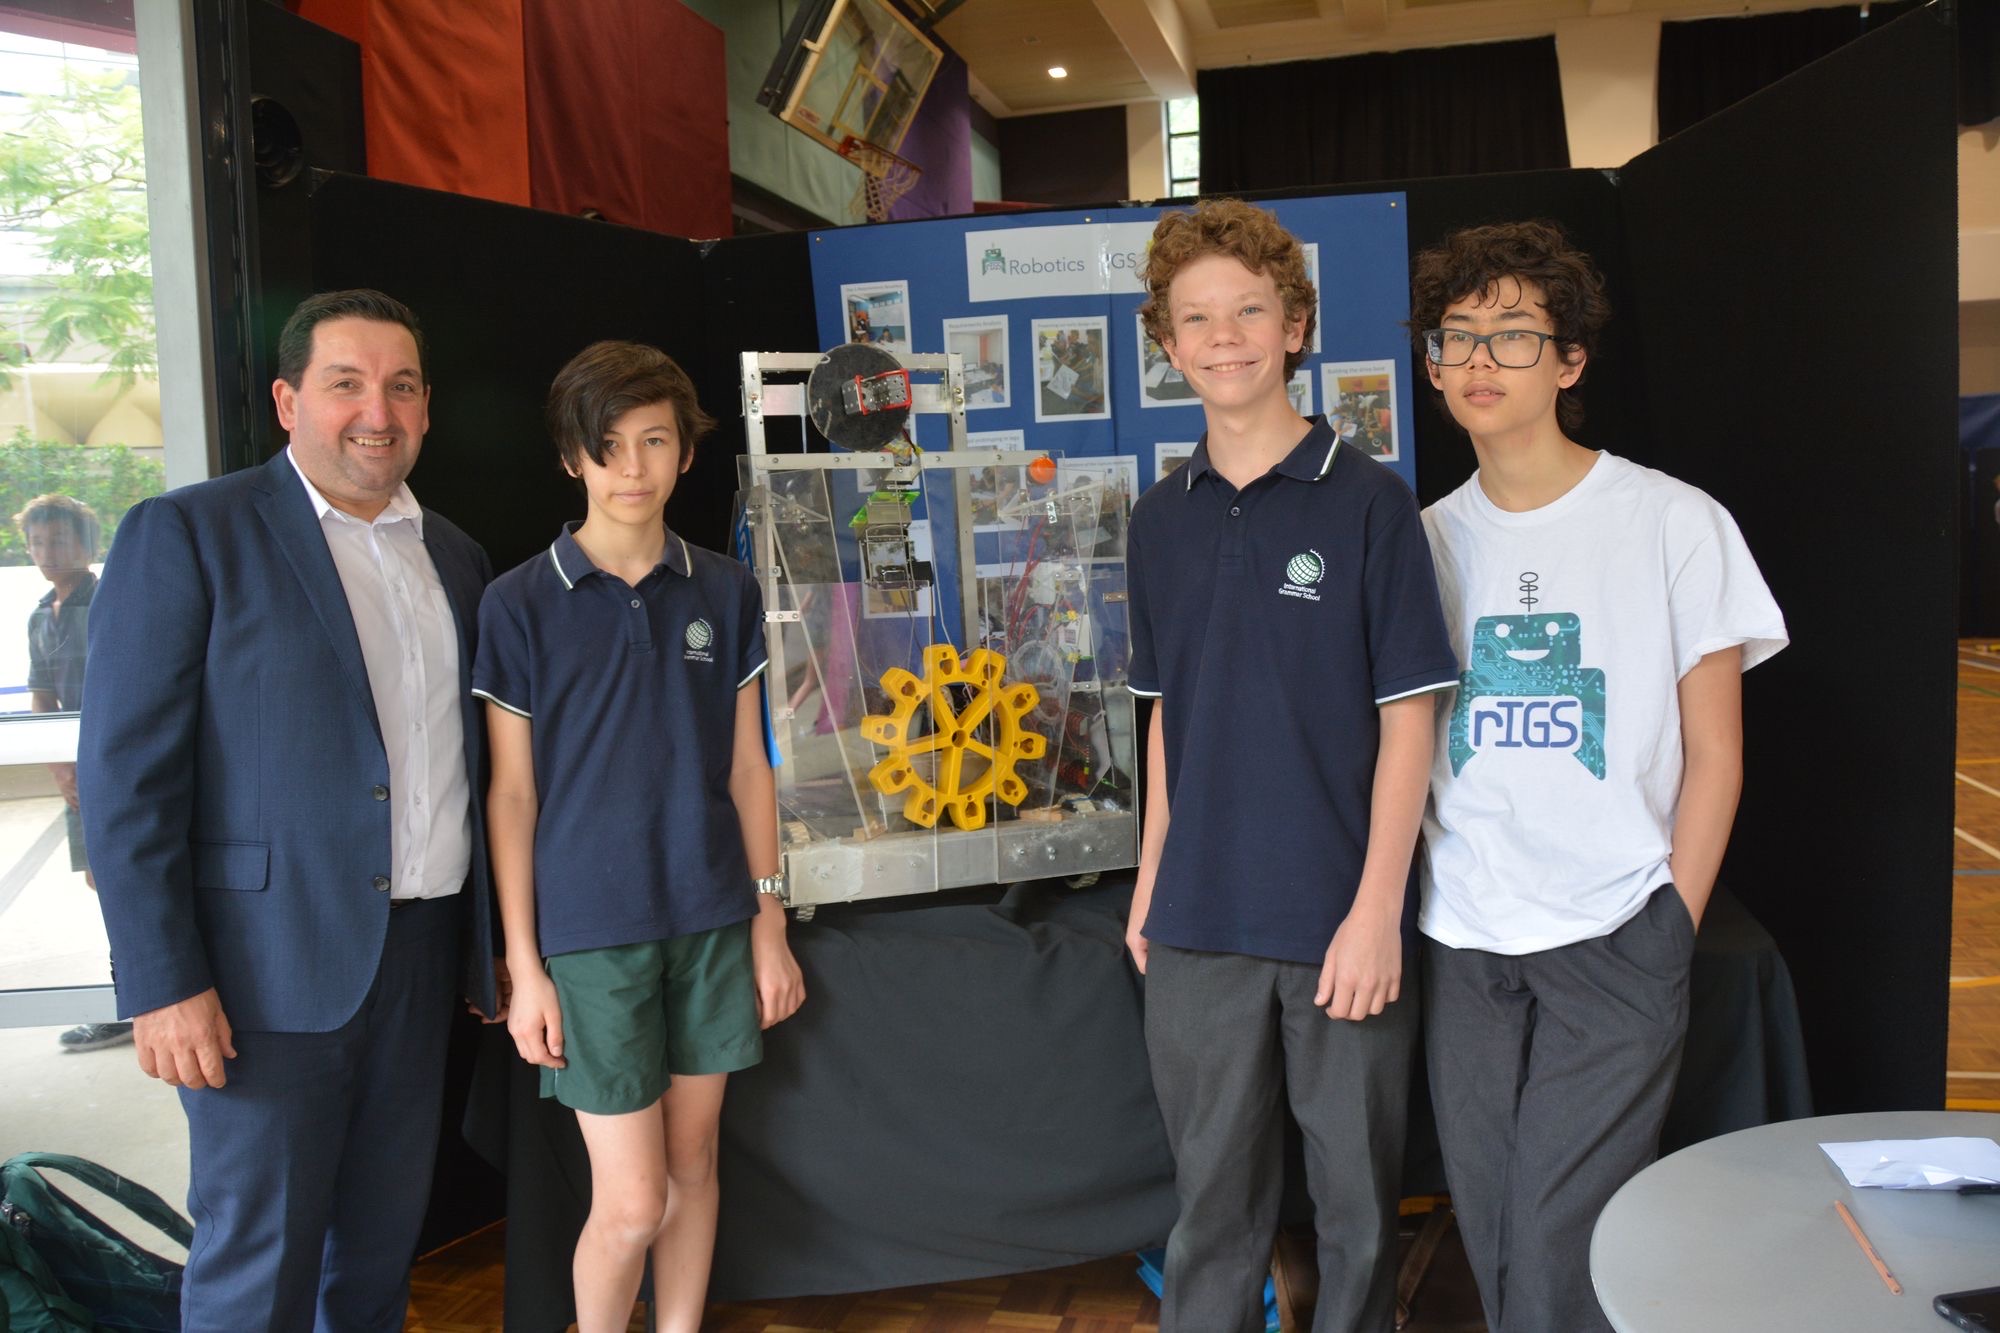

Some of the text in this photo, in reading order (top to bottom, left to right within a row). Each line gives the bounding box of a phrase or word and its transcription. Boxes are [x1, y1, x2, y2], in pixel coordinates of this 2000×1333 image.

[1009, 256, 1085, 276] Robotics
[1303, 592, 1321, 601] School
[1473, 700, 1579, 748] rIGS
